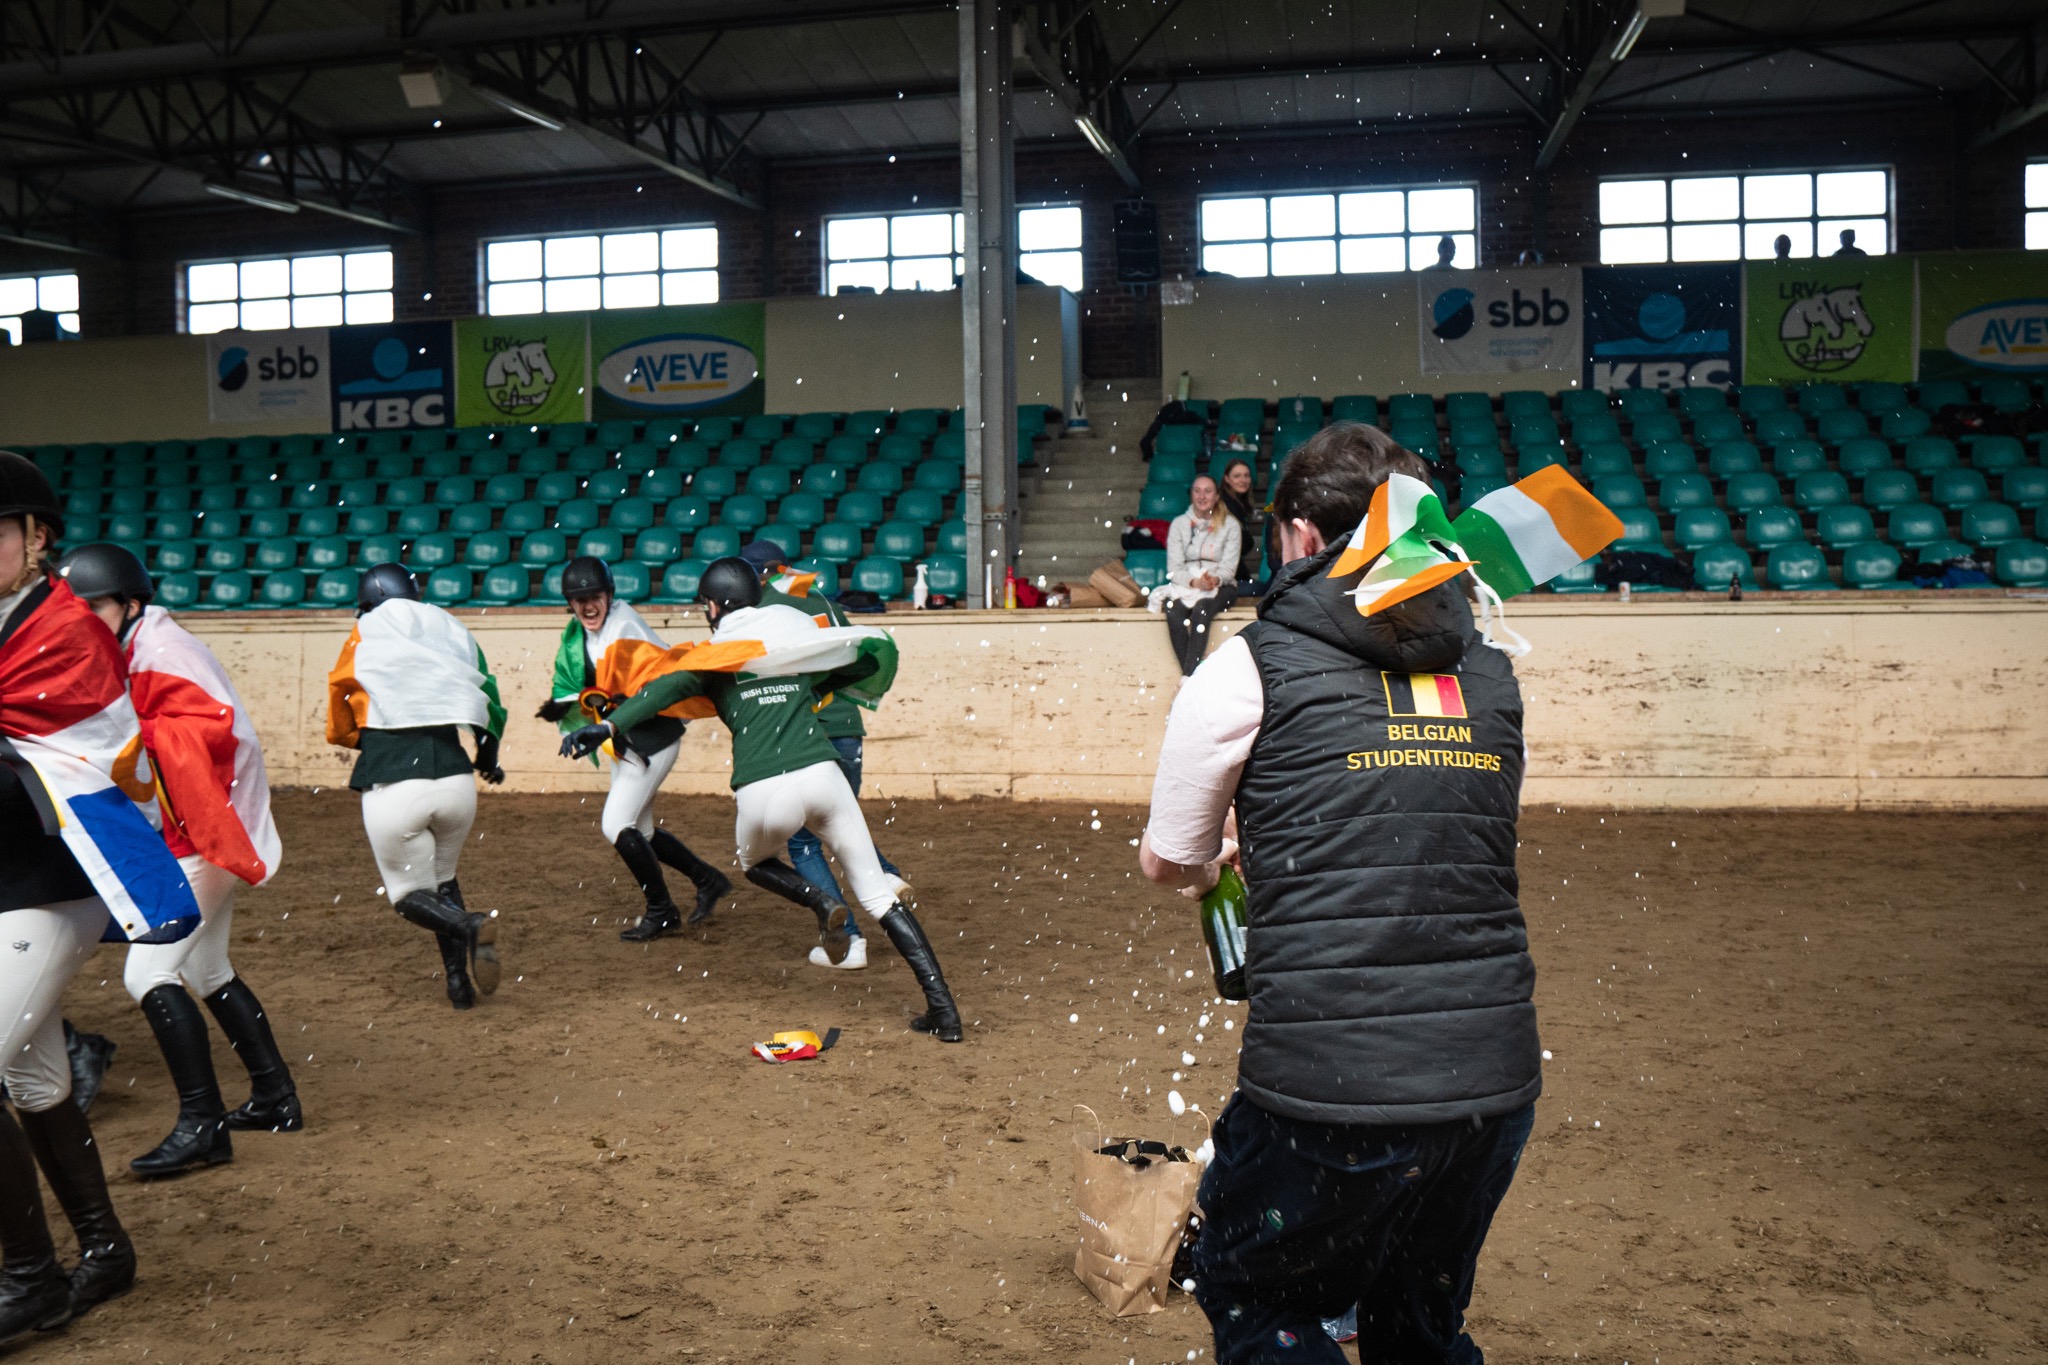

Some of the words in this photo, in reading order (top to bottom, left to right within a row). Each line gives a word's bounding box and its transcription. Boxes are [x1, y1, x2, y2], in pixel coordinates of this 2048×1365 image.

[1487, 288, 1570, 328] sbb
[1980, 317, 2048, 353] AVE
[258, 346, 319, 381] sbb
[630, 352, 728, 392] AVEVE
[1593, 360, 1731, 393] KBC
[339, 394, 446, 430] KBC
[1075, 401, 1084, 416] V
[740, 687, 763, 700] IRISH
[762, 684, 800, 694] STUDENT
[758, 694, 787, 705] RIDERS
[1387, 723, 1472, 743] BELGIAN
[1347, 749, 1502, 772] STUDENTRIDERS
